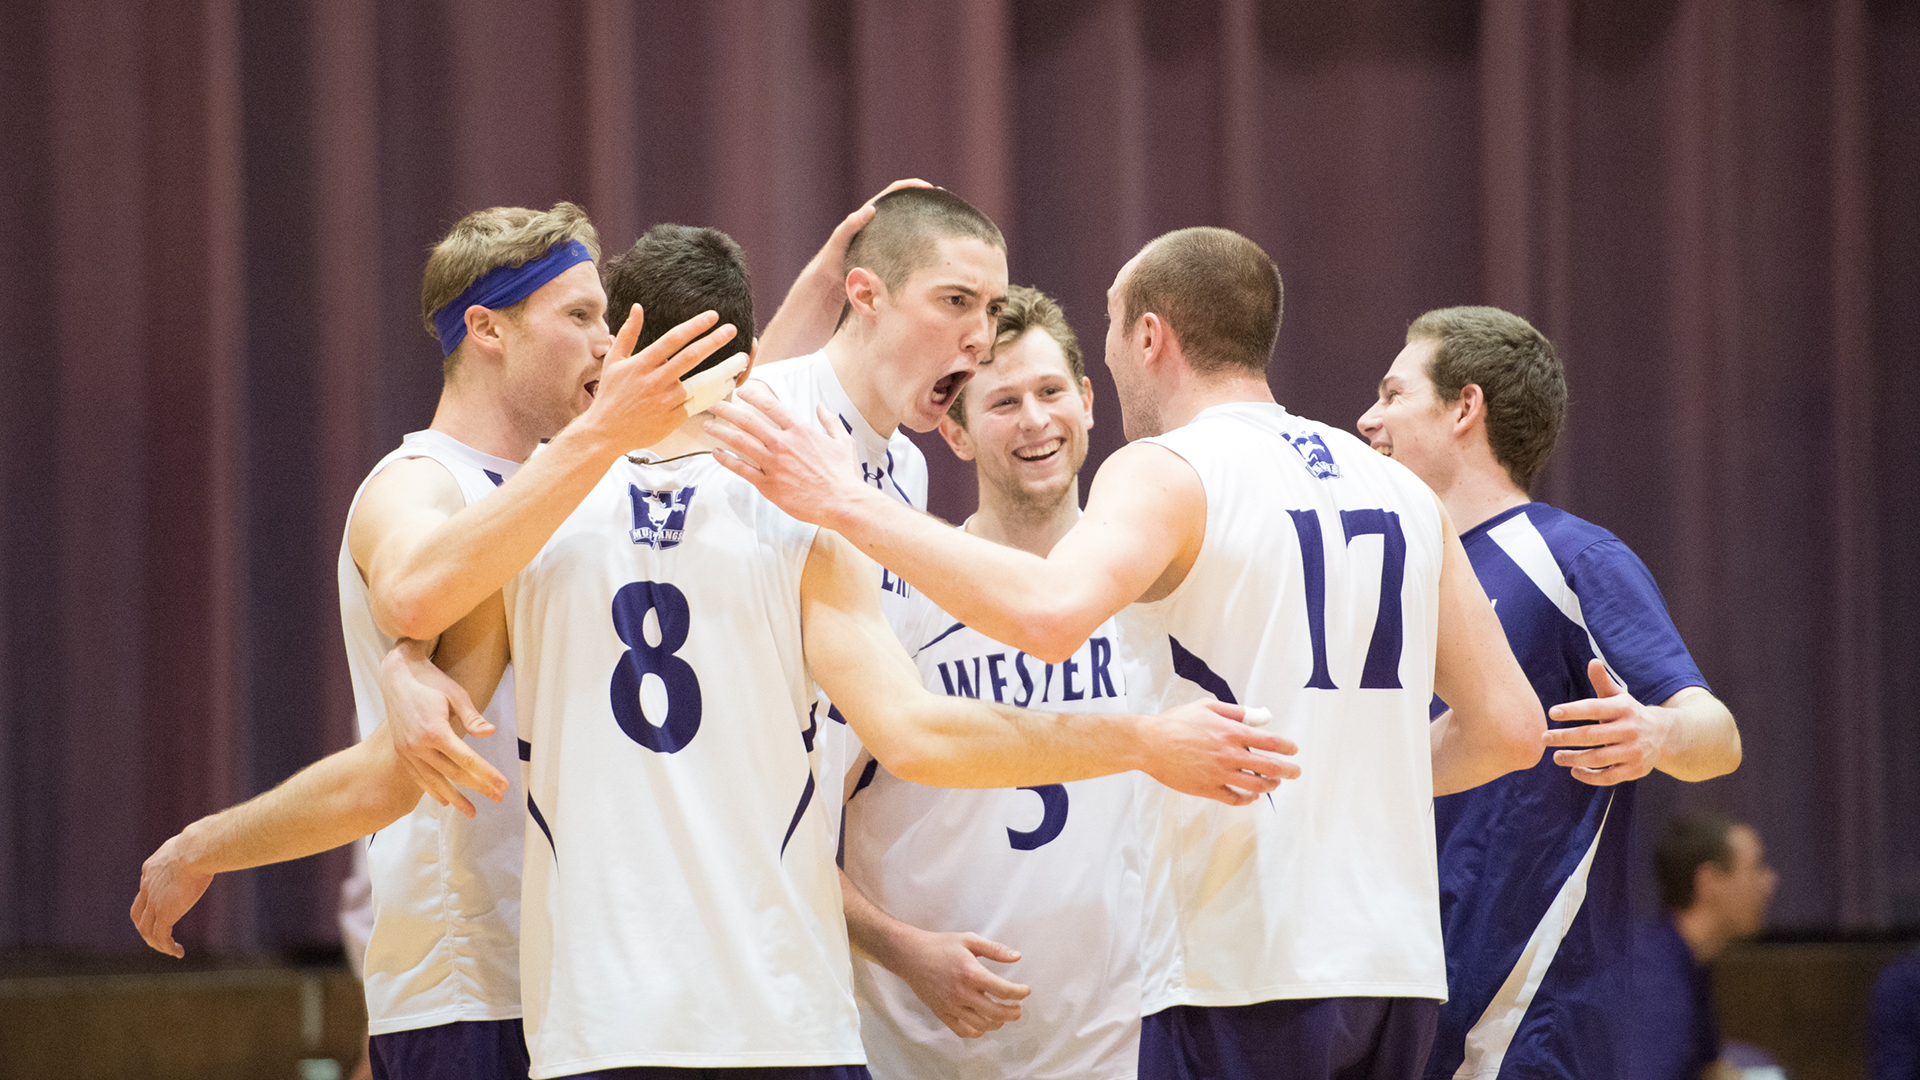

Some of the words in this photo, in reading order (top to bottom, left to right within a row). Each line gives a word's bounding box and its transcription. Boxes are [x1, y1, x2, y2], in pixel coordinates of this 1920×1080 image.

[610, 580, 703, 754] 8
[937, 636, 1127, 708] WESTER
[1285, 508, 1407, 690] 17
